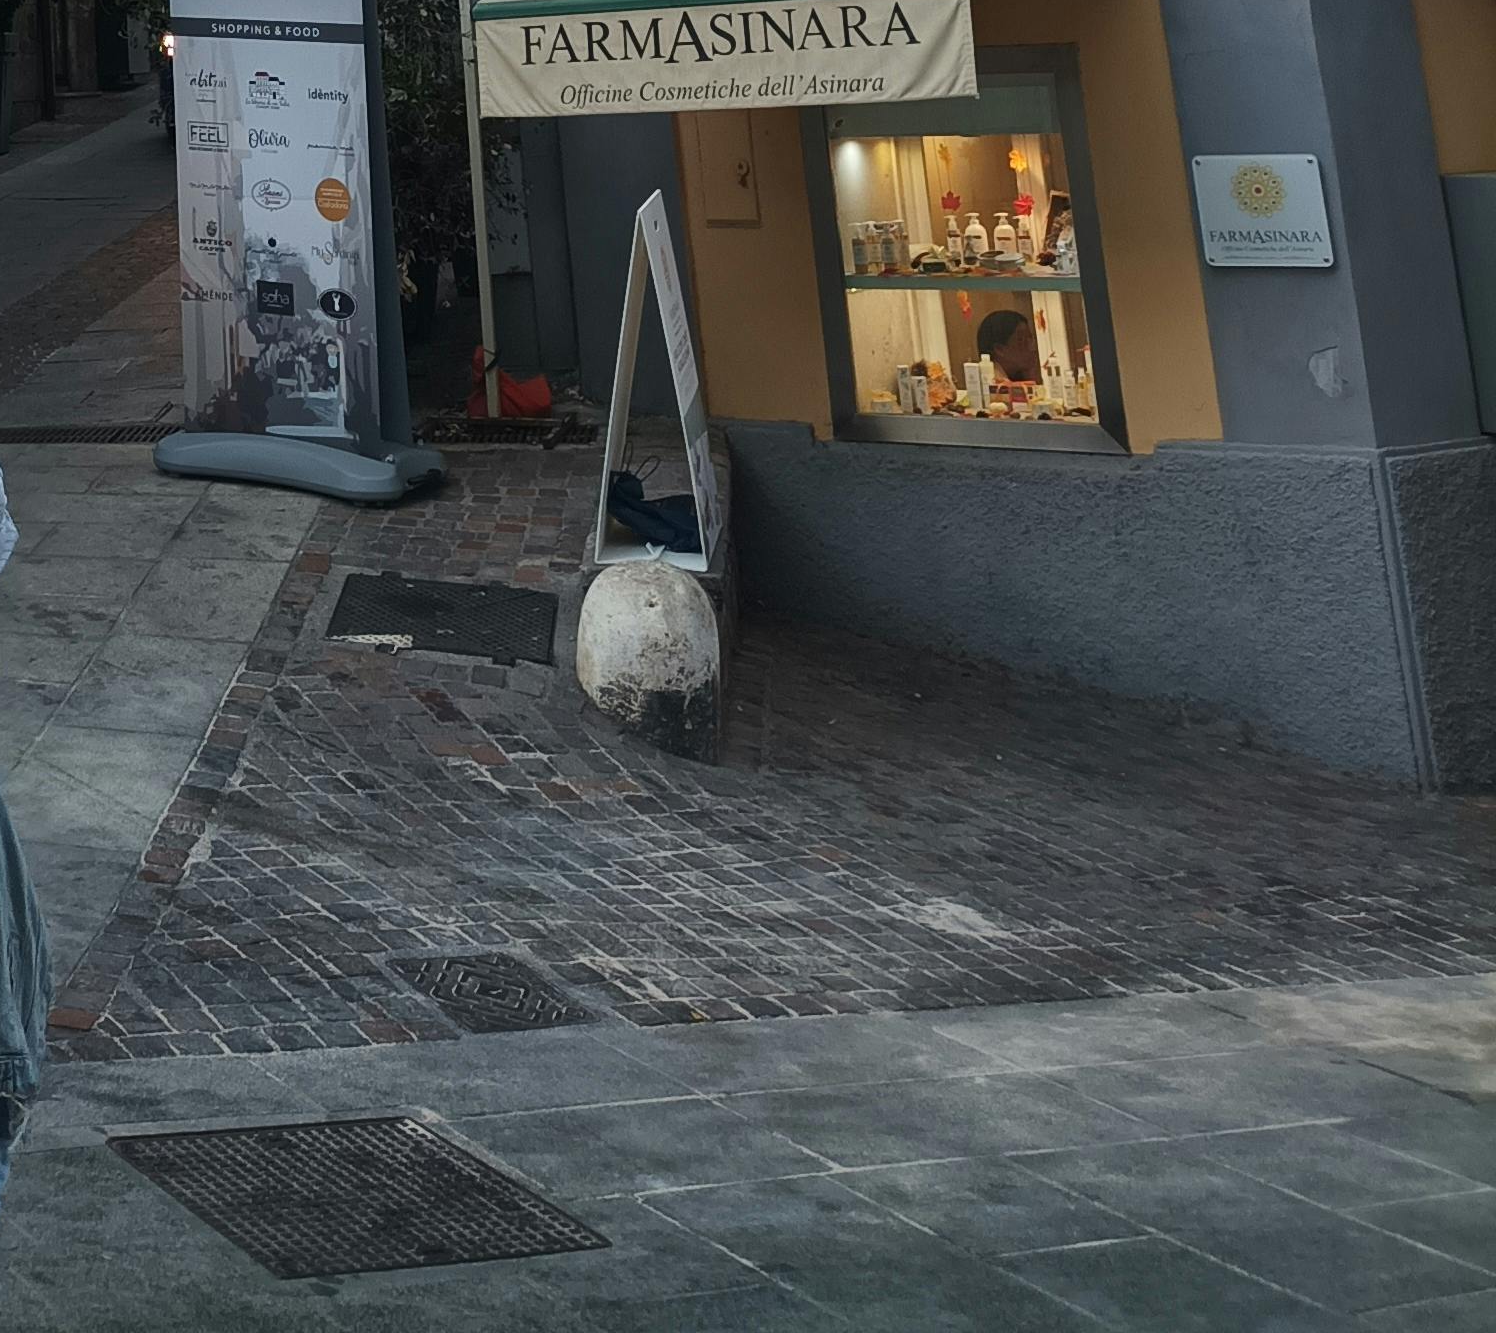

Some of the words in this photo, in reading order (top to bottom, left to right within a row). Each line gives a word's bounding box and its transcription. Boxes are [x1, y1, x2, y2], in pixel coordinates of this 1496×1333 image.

[211, 23, 271, 36] SHOPPING
[274, 25, 282, 36] &
[285, 26, 320, 38] FOOD
[520, 1, 921, 66] FARMASINARA
[560, 83, 633, 110] Officine
[639, 77, 752, 103] Cosmetiche
[190, 124, 226, 143] FEEL
[192, 237, 233, 246] ANTICO
[1209, 229, 1323, 245] FARMASINARA
